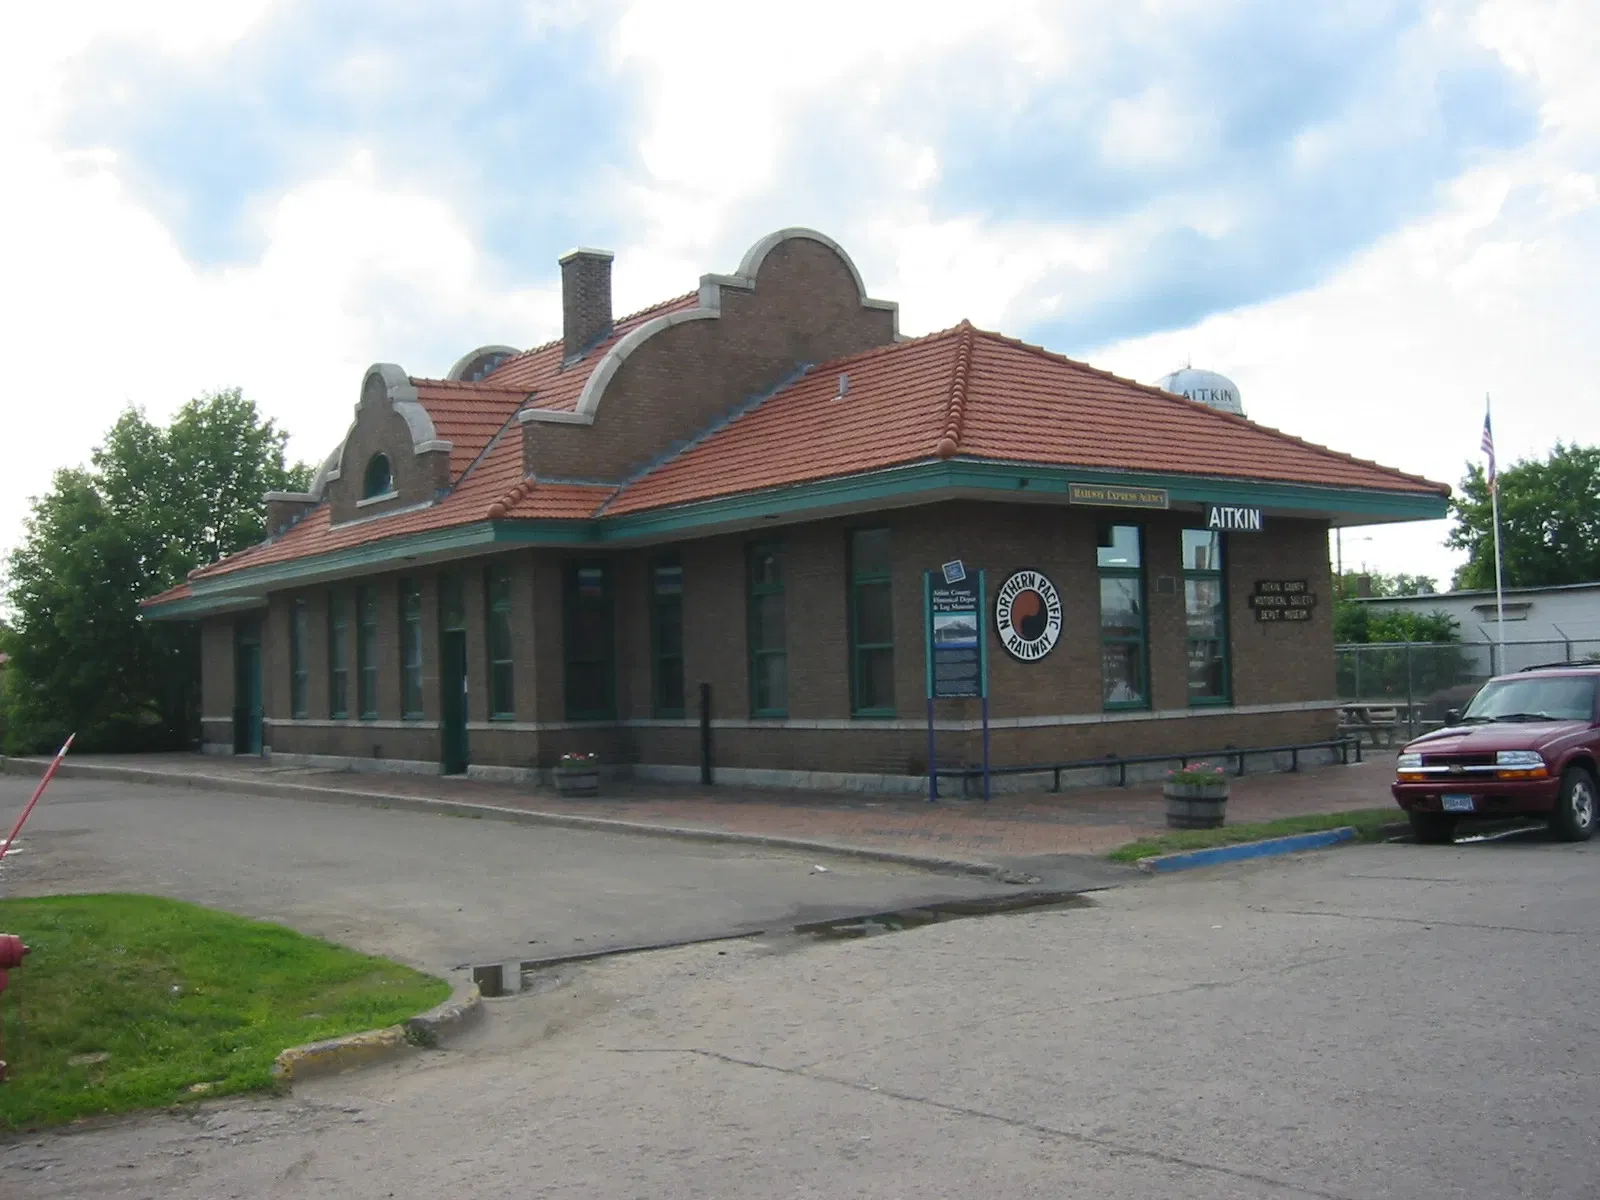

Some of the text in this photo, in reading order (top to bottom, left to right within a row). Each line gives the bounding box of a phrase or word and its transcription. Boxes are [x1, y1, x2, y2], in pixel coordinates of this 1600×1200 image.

[1183, 388, 1232, 401] AITKIN
[1107, 490, 1137, 501] EXPRESS
[1209, 506, 1260, 530] AITKIN
[998, 572, 1061, 631] NORTHERN PACIFIC
[1007, 633, 1052, 658] RAILWAY
